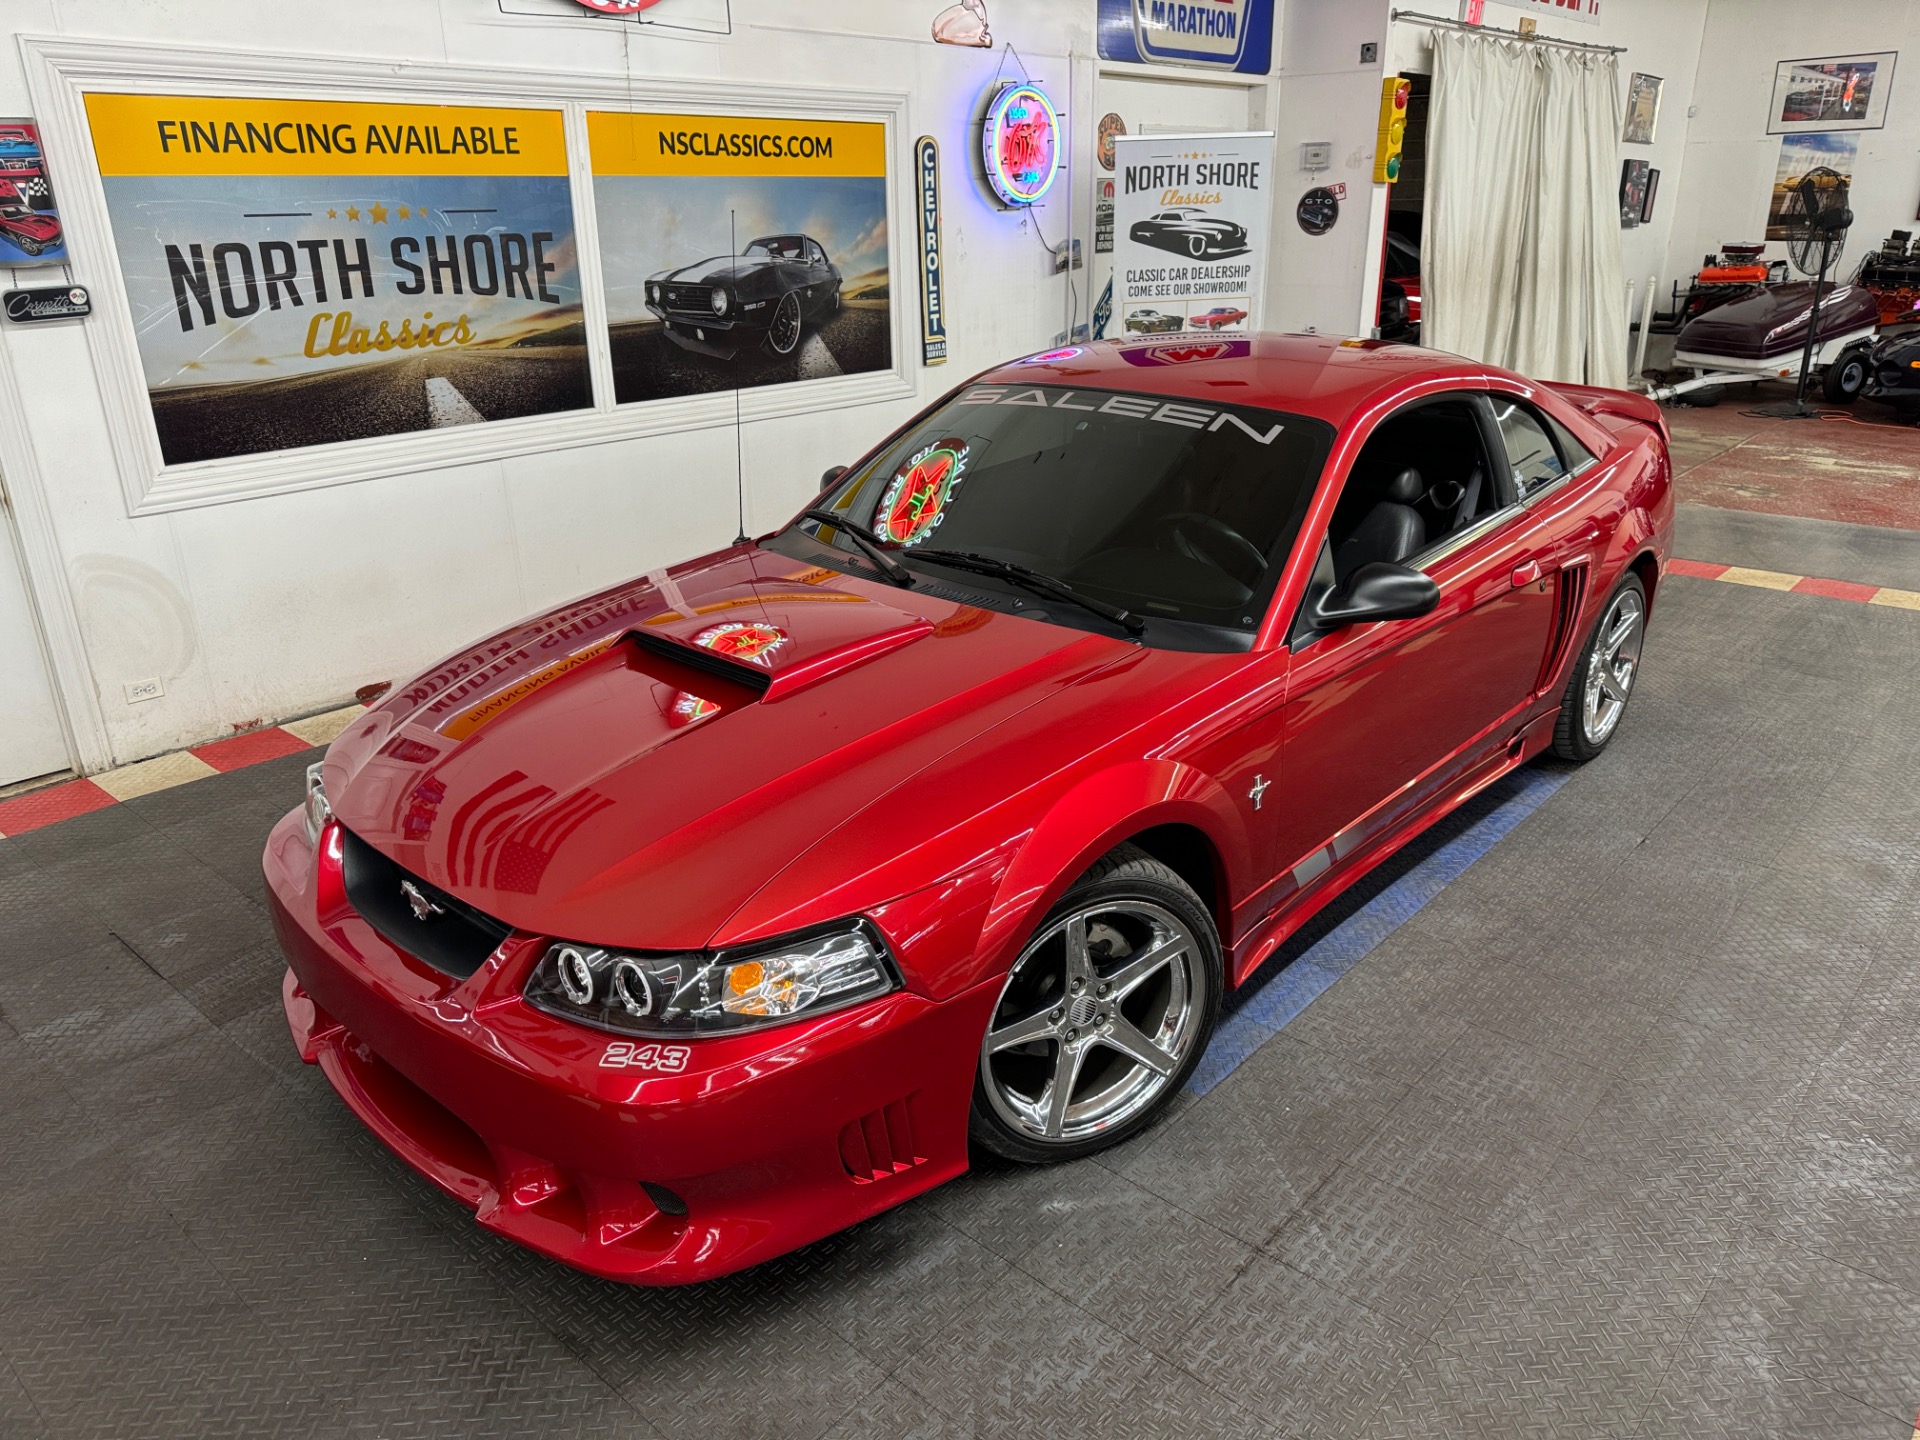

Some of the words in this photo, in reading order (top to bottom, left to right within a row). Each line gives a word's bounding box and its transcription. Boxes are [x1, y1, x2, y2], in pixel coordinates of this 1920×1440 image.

[1151, 0, 1237, 39] MARATHON
[157, 120, 357, 154] FINANCING
[365, 124, 521, 155] AVAILABLE
[659, 131, 833, 158] NSCLASSICS.COM
[1125, 164, 1190, 195] NORTH
[1196, 162, 1260, 190] SHORE
[1160, 189, 1223, 206] Classics
[923, 148, 940, 332] CHEVROLET
[164, 238, 375, 333] NORTH
[390, 231, 560, 304] SHORE
[1127, 268, 1165, 283] CLASSIC
[1169, 267, 1188, 281] CAR
[1191, 265, 1251, 279] DEALERSHIP
[1128, 284, 1153, 297] COME
[1155, 283, 1171, 296] SEE
[1174, 283, 1190, 295] OUR
[1194, 281, 1247, 294] SHOWROOM!
[8, 294, 72, 317] Corvette
[303, 311, 477, 359] Classics
[958, 388, 1285, 445] SALEEN
[599, 1042, 691, 1072] 243
